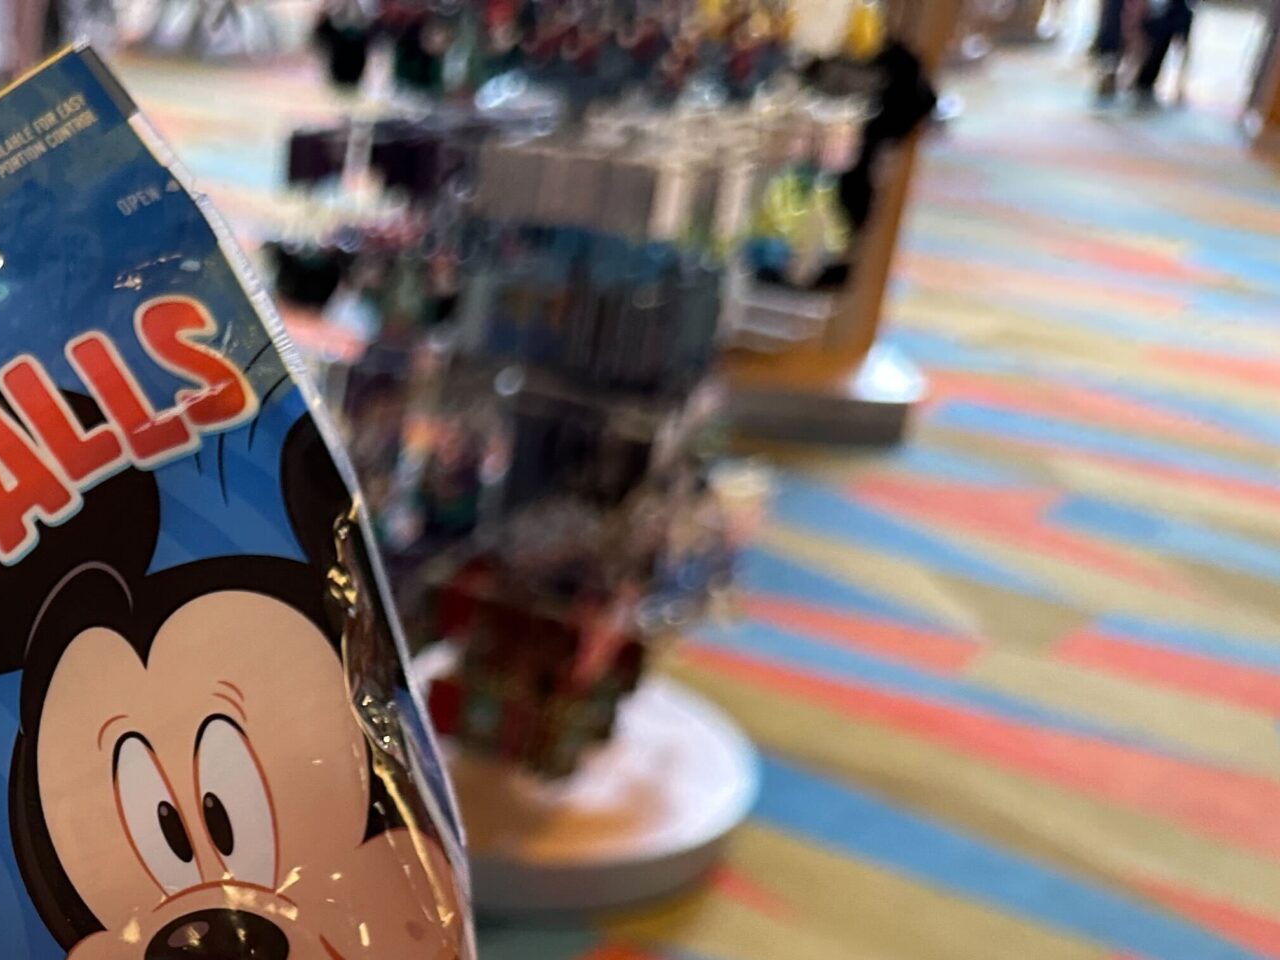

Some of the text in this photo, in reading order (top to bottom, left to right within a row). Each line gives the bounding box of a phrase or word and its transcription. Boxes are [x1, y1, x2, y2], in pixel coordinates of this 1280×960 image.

[33, 110, 56, 134] FOR
[55, 94, 86, 118] EASY
[46, 110, 97, 148] CONTROL
[117, 186, 161, 217] OPEN
